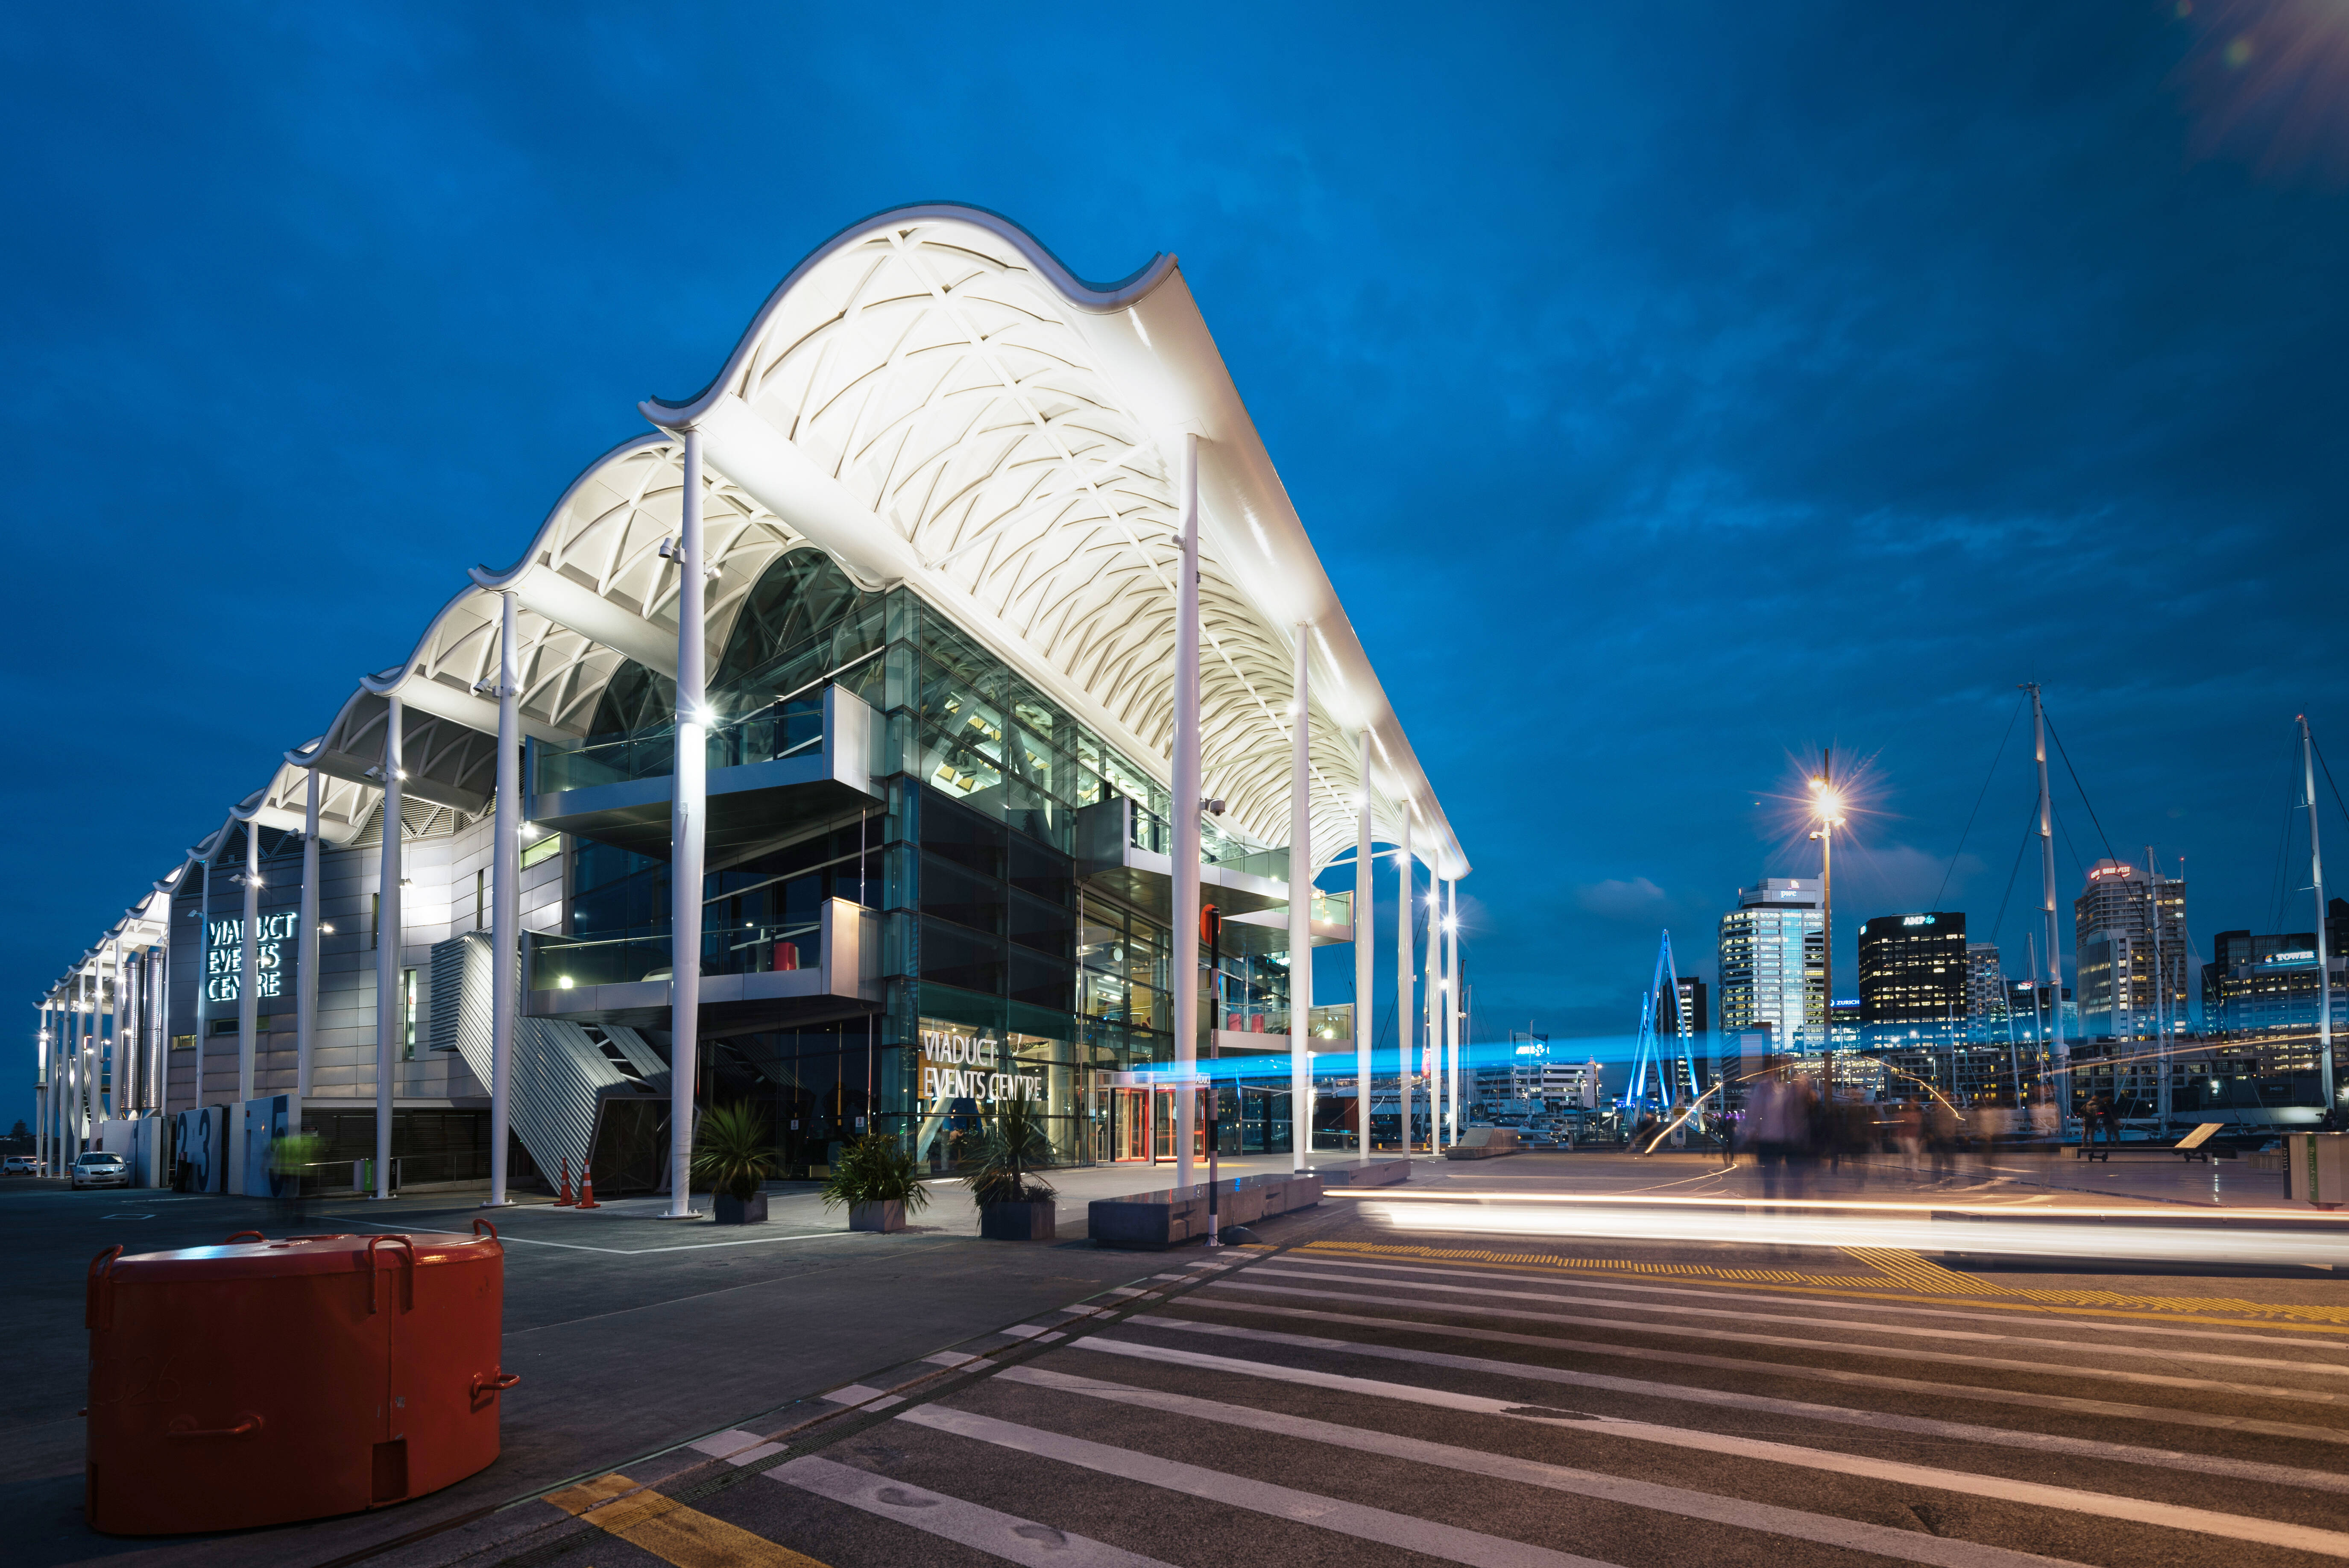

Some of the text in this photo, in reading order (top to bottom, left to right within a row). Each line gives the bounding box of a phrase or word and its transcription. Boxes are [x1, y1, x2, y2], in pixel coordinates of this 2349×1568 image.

[207, 912, 296, 946] VIAUCT
[1904, 916, 1925, 925] AMP
[207, 943, 279, 973] EVETS
[2276, 951, 2314, 961] TOWER
[205, 971, 280, 1001] CENRE
[922, 1031, 997, 1067] VIADUCT
[924, 1067, 1042, 1102] EVENTS CENTRE
[197, 1109, 211, 1192] 3
